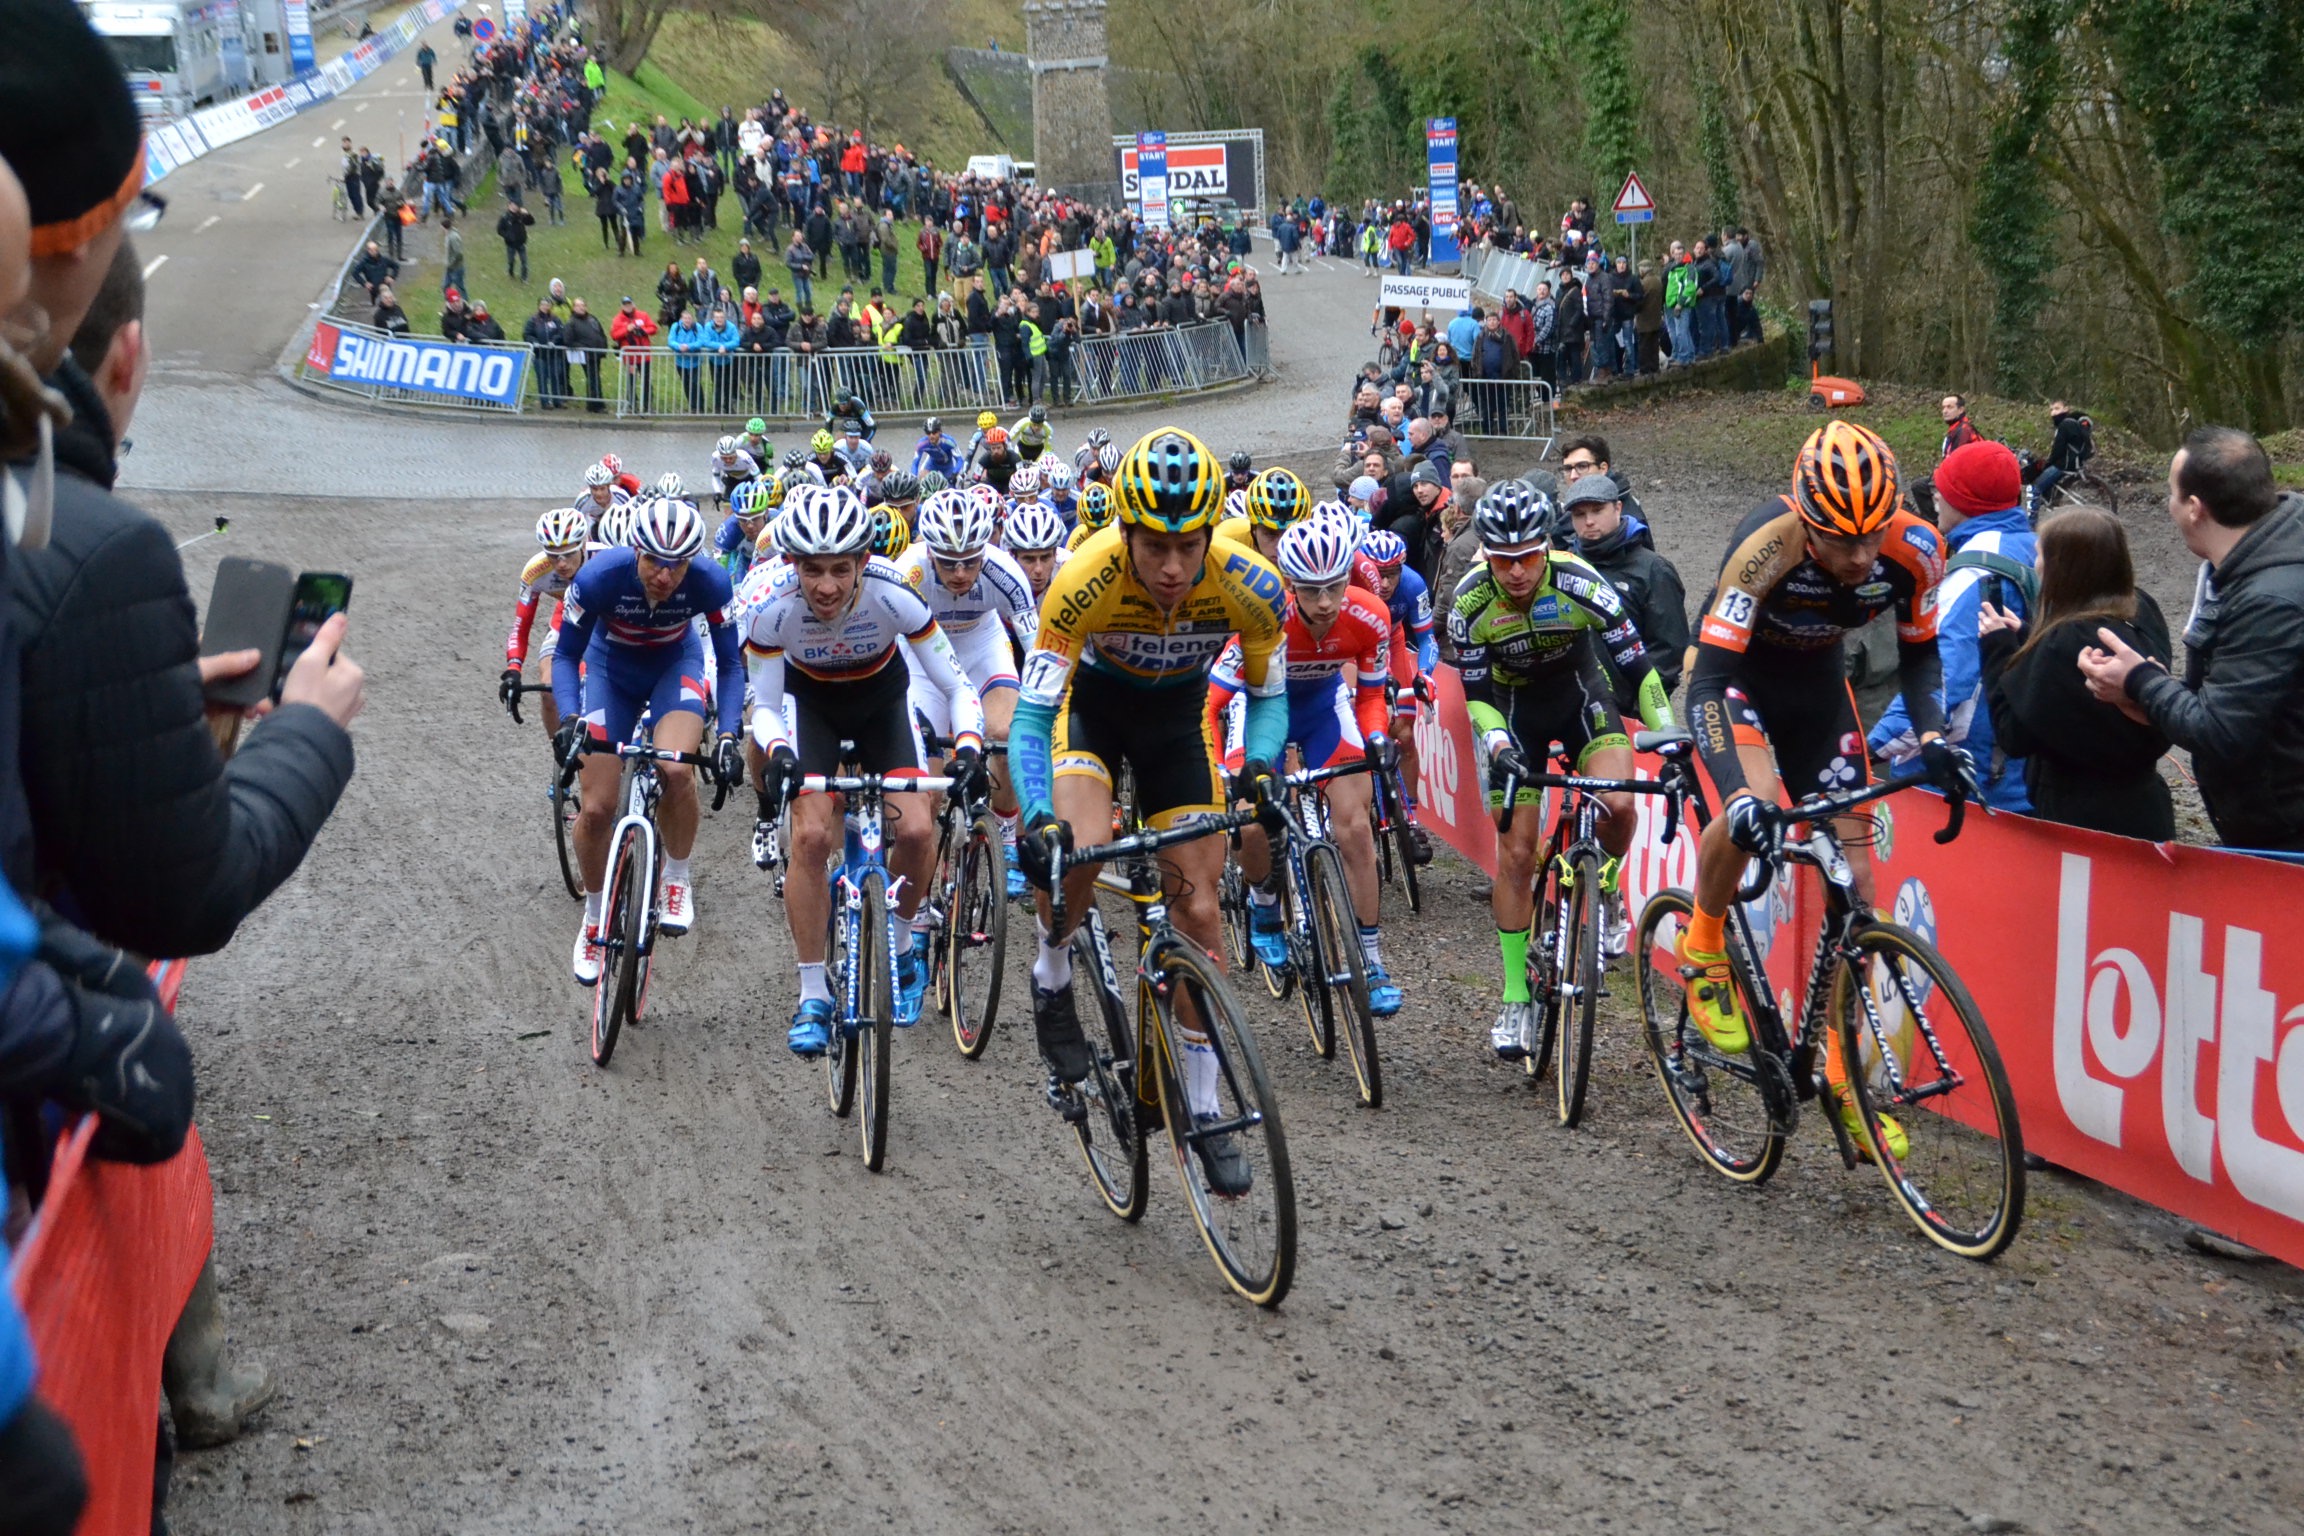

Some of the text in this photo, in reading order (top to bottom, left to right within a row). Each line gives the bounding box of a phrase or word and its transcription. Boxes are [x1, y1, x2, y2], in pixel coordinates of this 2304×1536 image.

[1139, 151, 1165, 162] START
[1429, 138, 1455, 147] START
[1125, 169, 1225, 192] SUDAL
[1383, 283, 1468, 299] PASSAGE PUBLIC
[333, 335, 514, 397] SHIMANO
[1739, 534, 1785, 585] GOLDEN
[754, 594, 779, 615] Bank
[1050, 553, 1124, 633] telenet
[1596, 583, 1617, 608] 40
[1786, 582, 1833, 595] RODANIA
[614, 604, 646, 617] Rapha
[1019, 612, 1038, 633] 10
[1348, 604, 1390, 641] GIANT
[1723, 591, 1753, 624] 13
[803, 642, 878, 660] BK CP
[1026, 656, 1050, 690] 11
[1703, 700, 1727, 755] GOLDEN
[1567, 777, 1619, 787] RITCHEY
[1556, 898, 1569, 971] STEVENS
[847, 923, 859, 1007] COLNAGO
[887, 922, 901, 1006] COLNAGO
[1087, 906, 1122, 1001] RIDLEY
[1860, 985, 1901, 1085] COLNAGO
[1900, 974, 1950, 1072] COLNAGO
